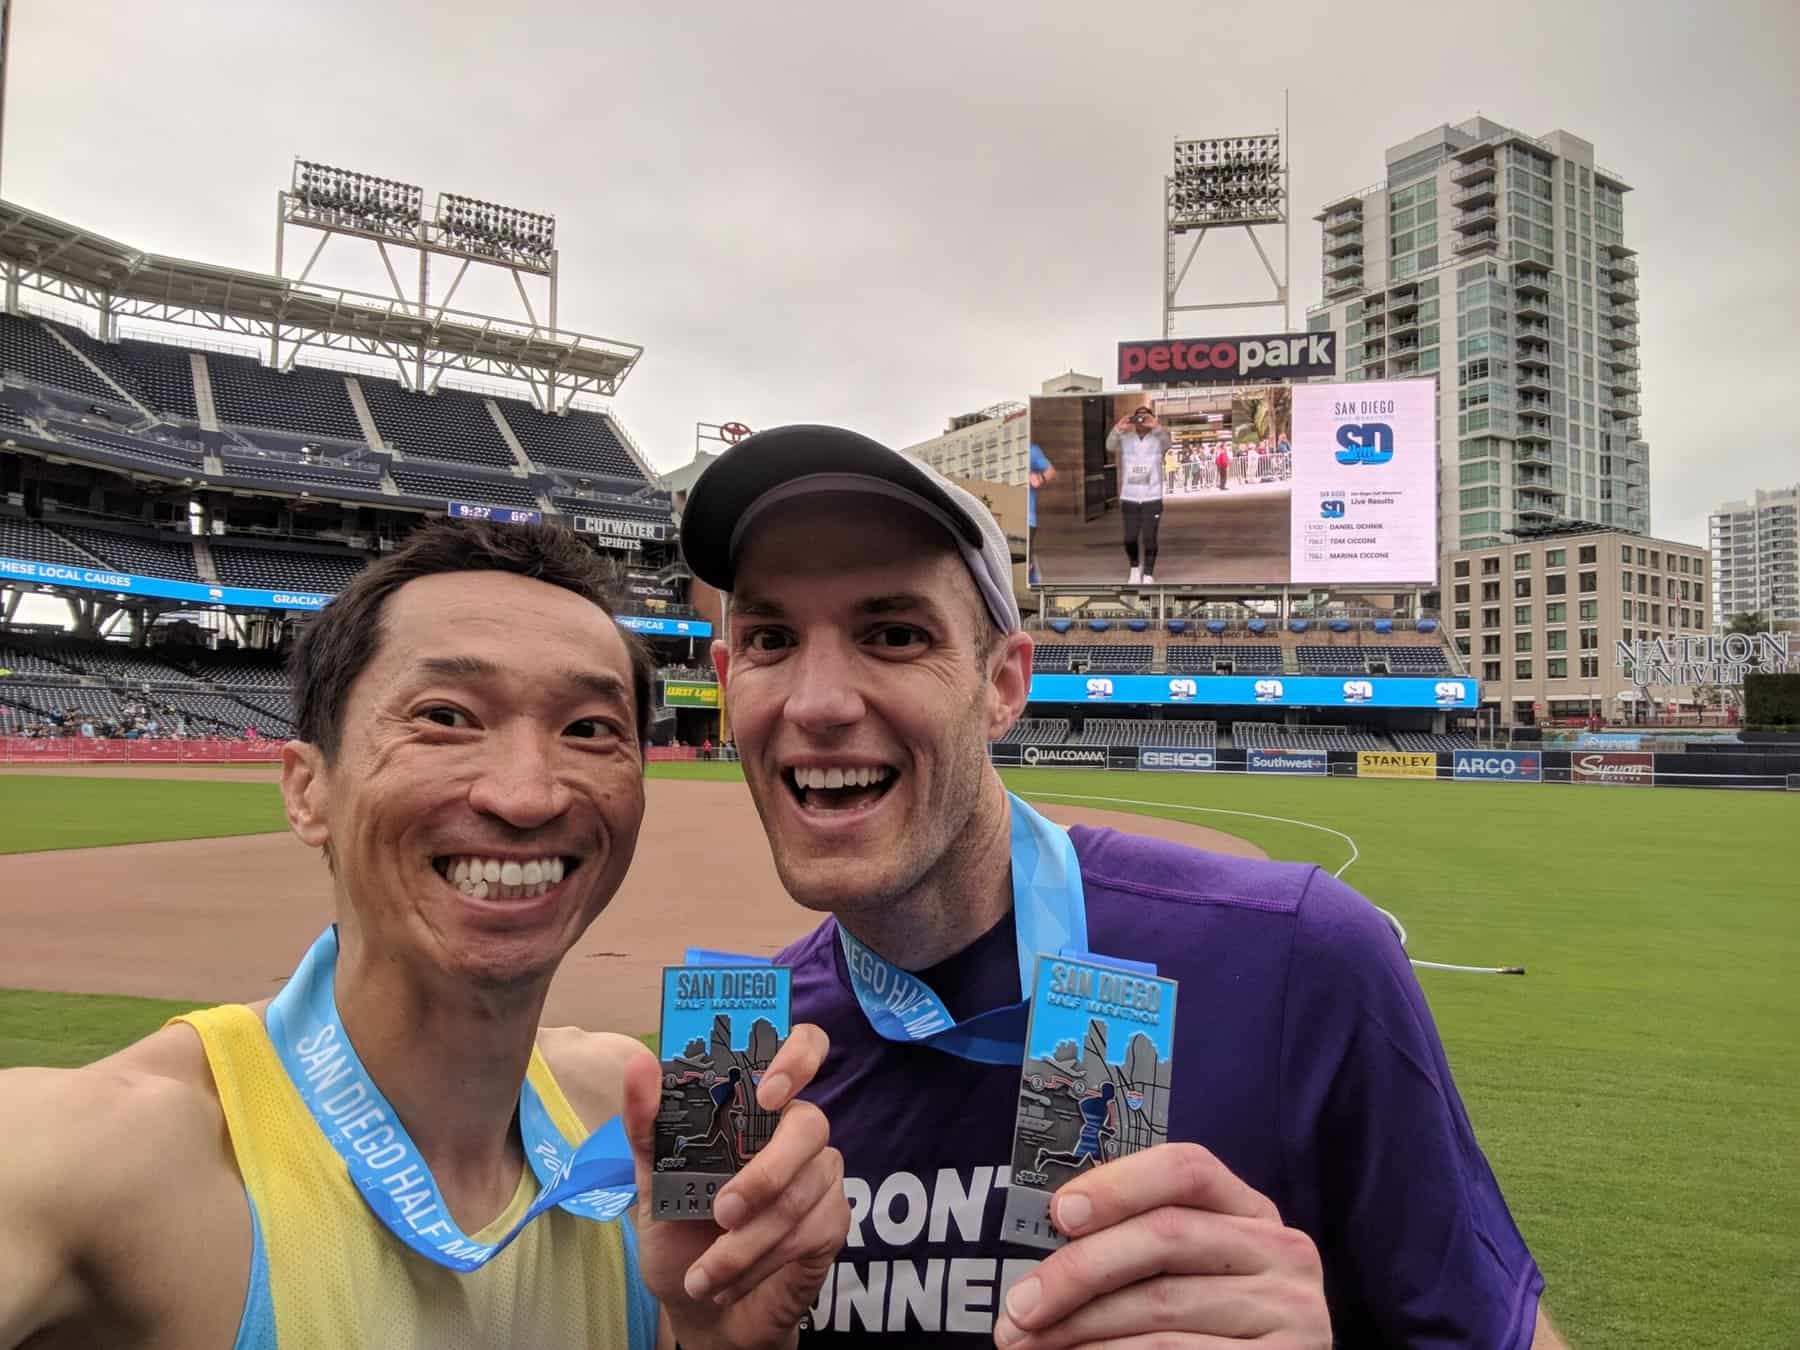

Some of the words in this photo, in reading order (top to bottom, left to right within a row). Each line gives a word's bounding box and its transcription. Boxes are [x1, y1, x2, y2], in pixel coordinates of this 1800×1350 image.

[1335, 402, 1356, 416] SAN
[1360, 399, 1394, 414] DIEGO
[585, 517, 655, 538] CUTWATER
[598, 536, 642, 550] SPIRITS
[0, 560, 36, 575] HESE
[39, 565, 81, 581] LOCAL
[84, 572, 131, 587] CAUSES
[1614, 631, 1791, 667] NATION
[1024, 746, 1105, 767] QUALCOMM
[1142, 752, 1212, 767] GEICO
[1252, 756, 1313, 769] Southwest
[1363, 755, 1430, 767] STANLEY
[1456, 757, 1516, 774] ARCO
[678, 971, 715, 1000] SAN
[722, 971, 777, 999] DIEGO
[1051, 962, 1094, 1000] SAN
[1098, 971, 1160, 1014] DIEGO
[673, 999, 705, 1009] HALF
[711, 999, 777, 1010] MARATHON
[296, 1023, 352, 1095] SAN
[321, 1081, 407, 1170] DIEGO
[382, 1163, 451, 1238] HALF
